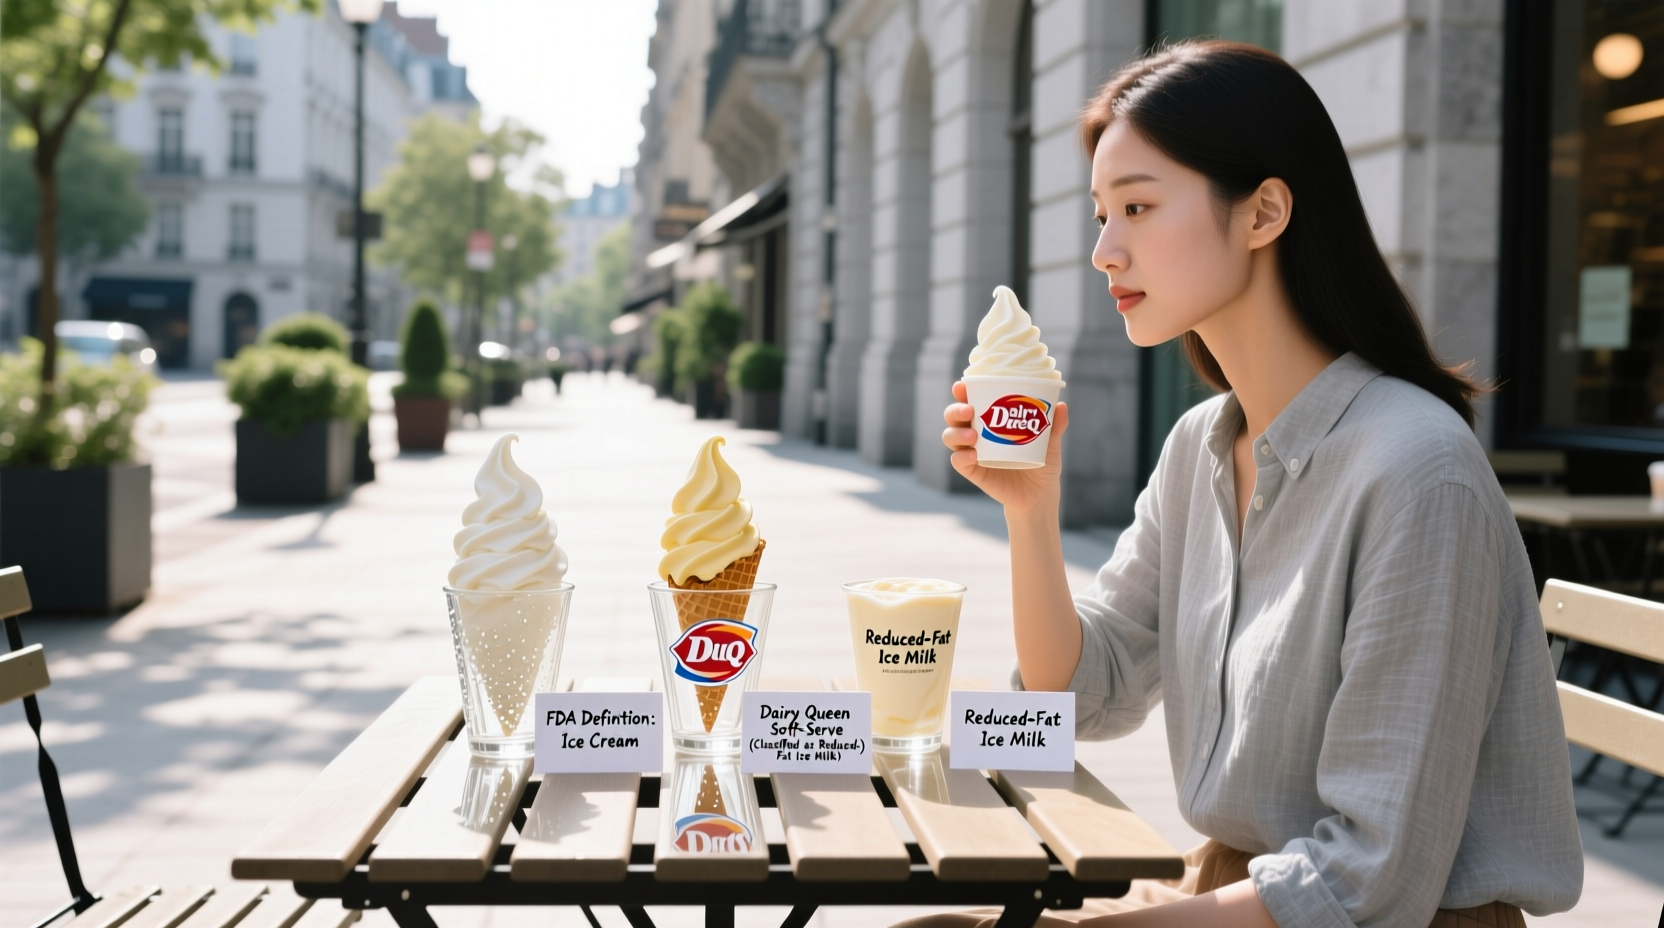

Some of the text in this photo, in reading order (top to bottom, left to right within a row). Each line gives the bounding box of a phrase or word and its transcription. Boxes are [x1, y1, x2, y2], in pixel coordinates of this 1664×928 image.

[865, 628, 952, 646] Reduced-Fat
[878, 647, 937, 665] Ice Milk
[546, 708, 656, 727] FDA Defintion:
[760, 704, 851, 725] Dairy Queen
[964, 707, 1062, 727] Reduced-Fat
[561, 732, 639, 749] Ice Cream
[979, 730, 1046, 748] Ice Milk
